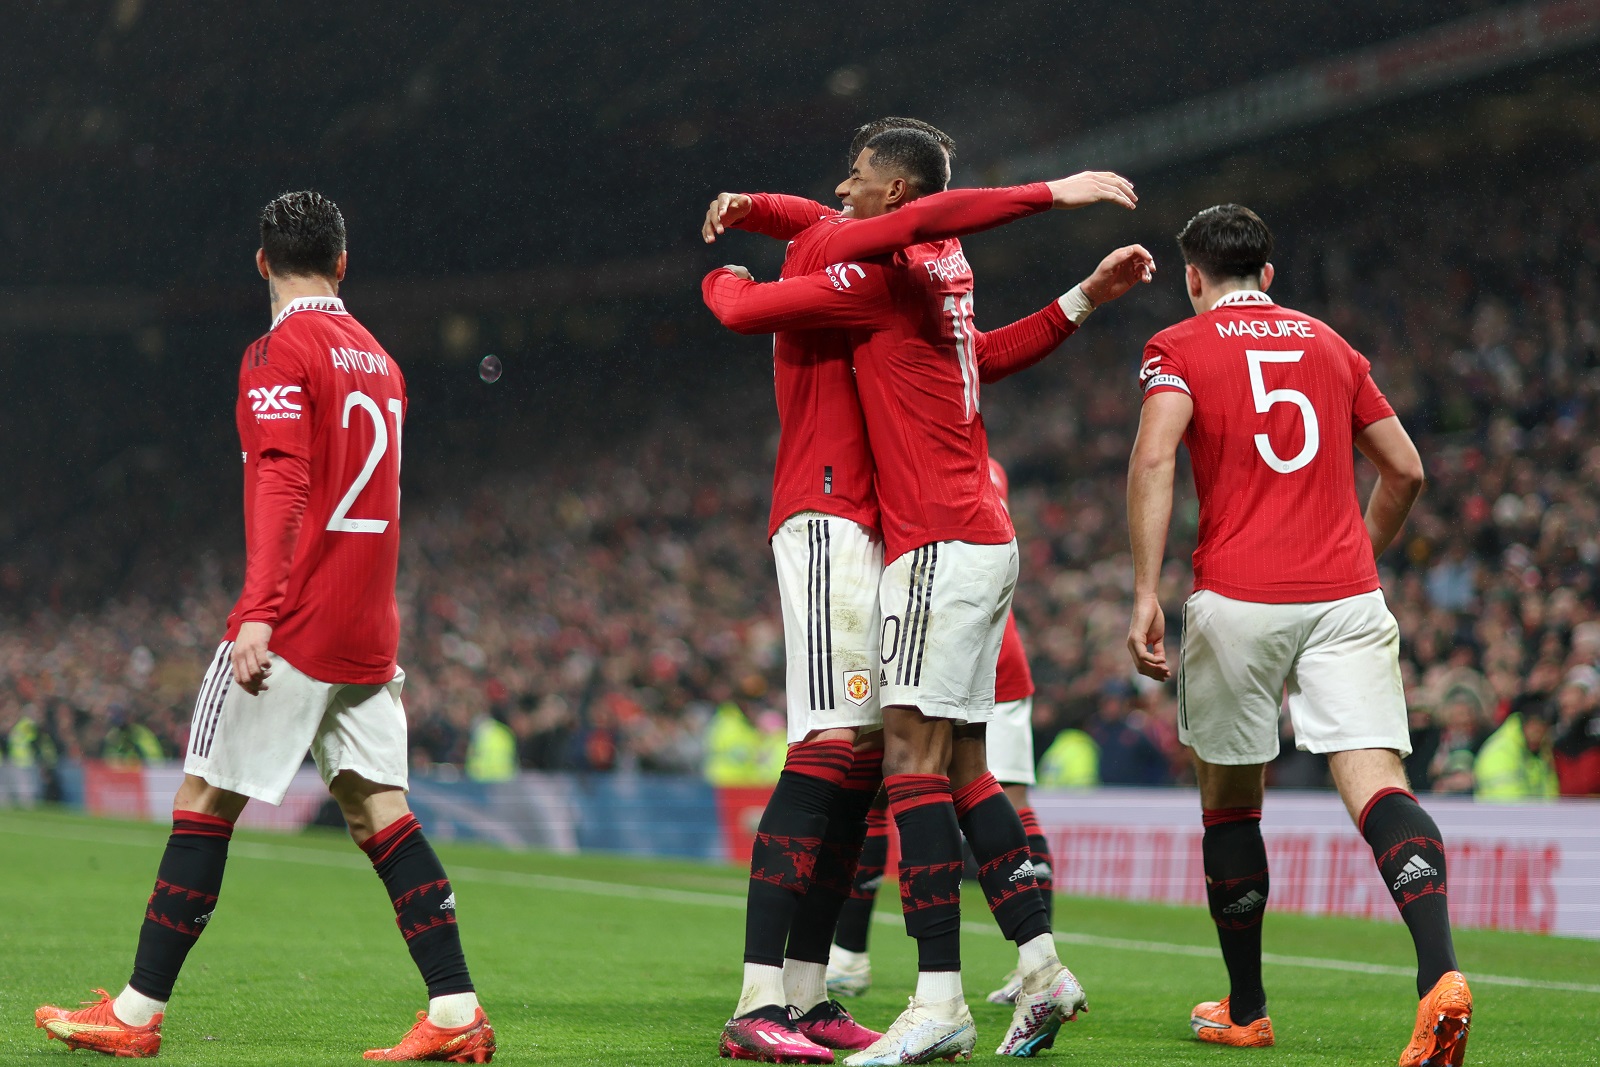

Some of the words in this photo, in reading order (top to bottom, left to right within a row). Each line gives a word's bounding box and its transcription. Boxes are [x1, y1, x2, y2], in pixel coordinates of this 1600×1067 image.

[1215, 320, 1315, 339] MAGUIRE
[331, 346, 389, 376] ANTONY
[1245, 350, 1319, 474] 5
[326, 391, 402, 533] 21
[1393, 868, 1438, 890] adidas
